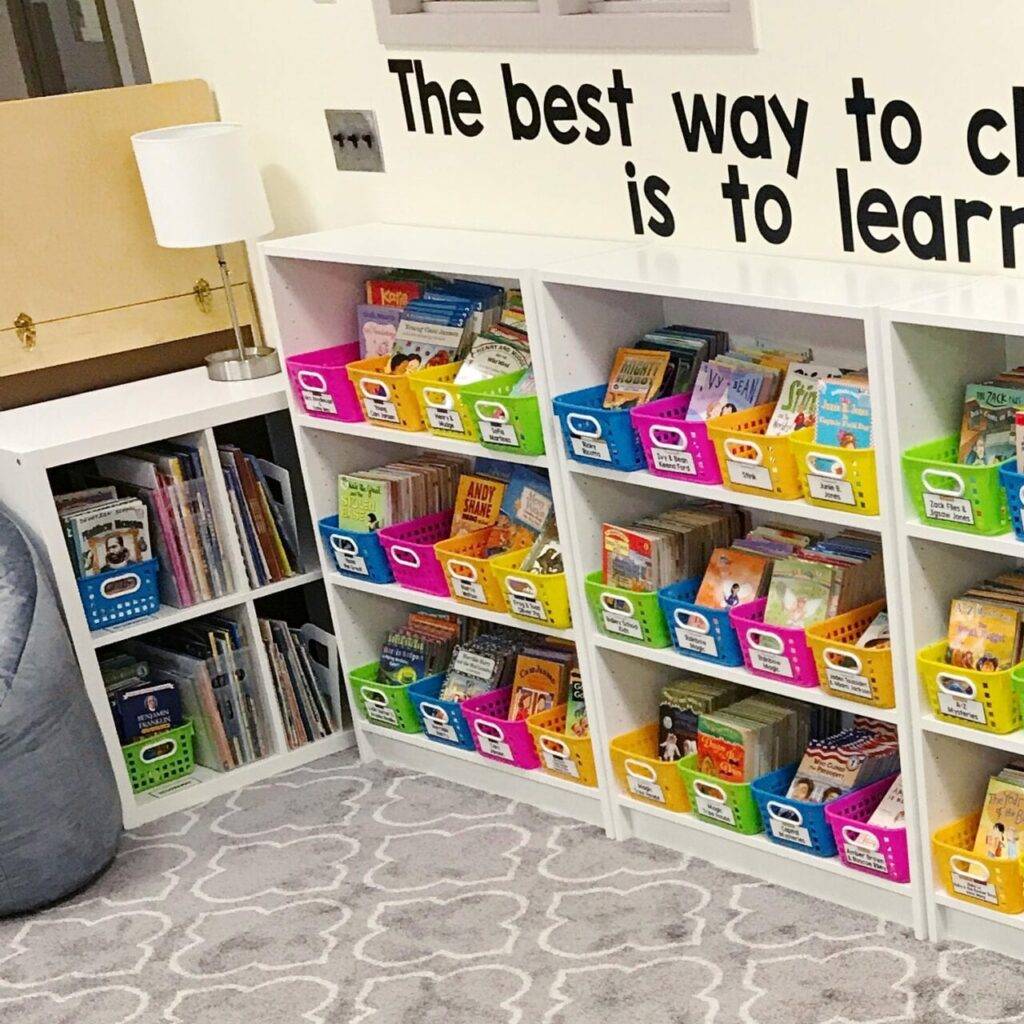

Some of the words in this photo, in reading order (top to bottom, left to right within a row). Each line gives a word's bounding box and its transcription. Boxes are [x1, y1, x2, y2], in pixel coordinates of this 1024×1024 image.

[388, 59, 484, 138] The
[501, 63, 634, 147] best
[672, 92, 809, 179] way
[845, 78, 922, 165] to
[625, 161, 676, 238] is
[722, 165, 792, 245] to
[467, 481, 497, 501] ANDY
[463, 498, 493, 519] SHANE
[929, 500, 946, 511] Zack
[947, 707, 979, 721] Mysteries
[956, 701, 968, 711] A-Z
